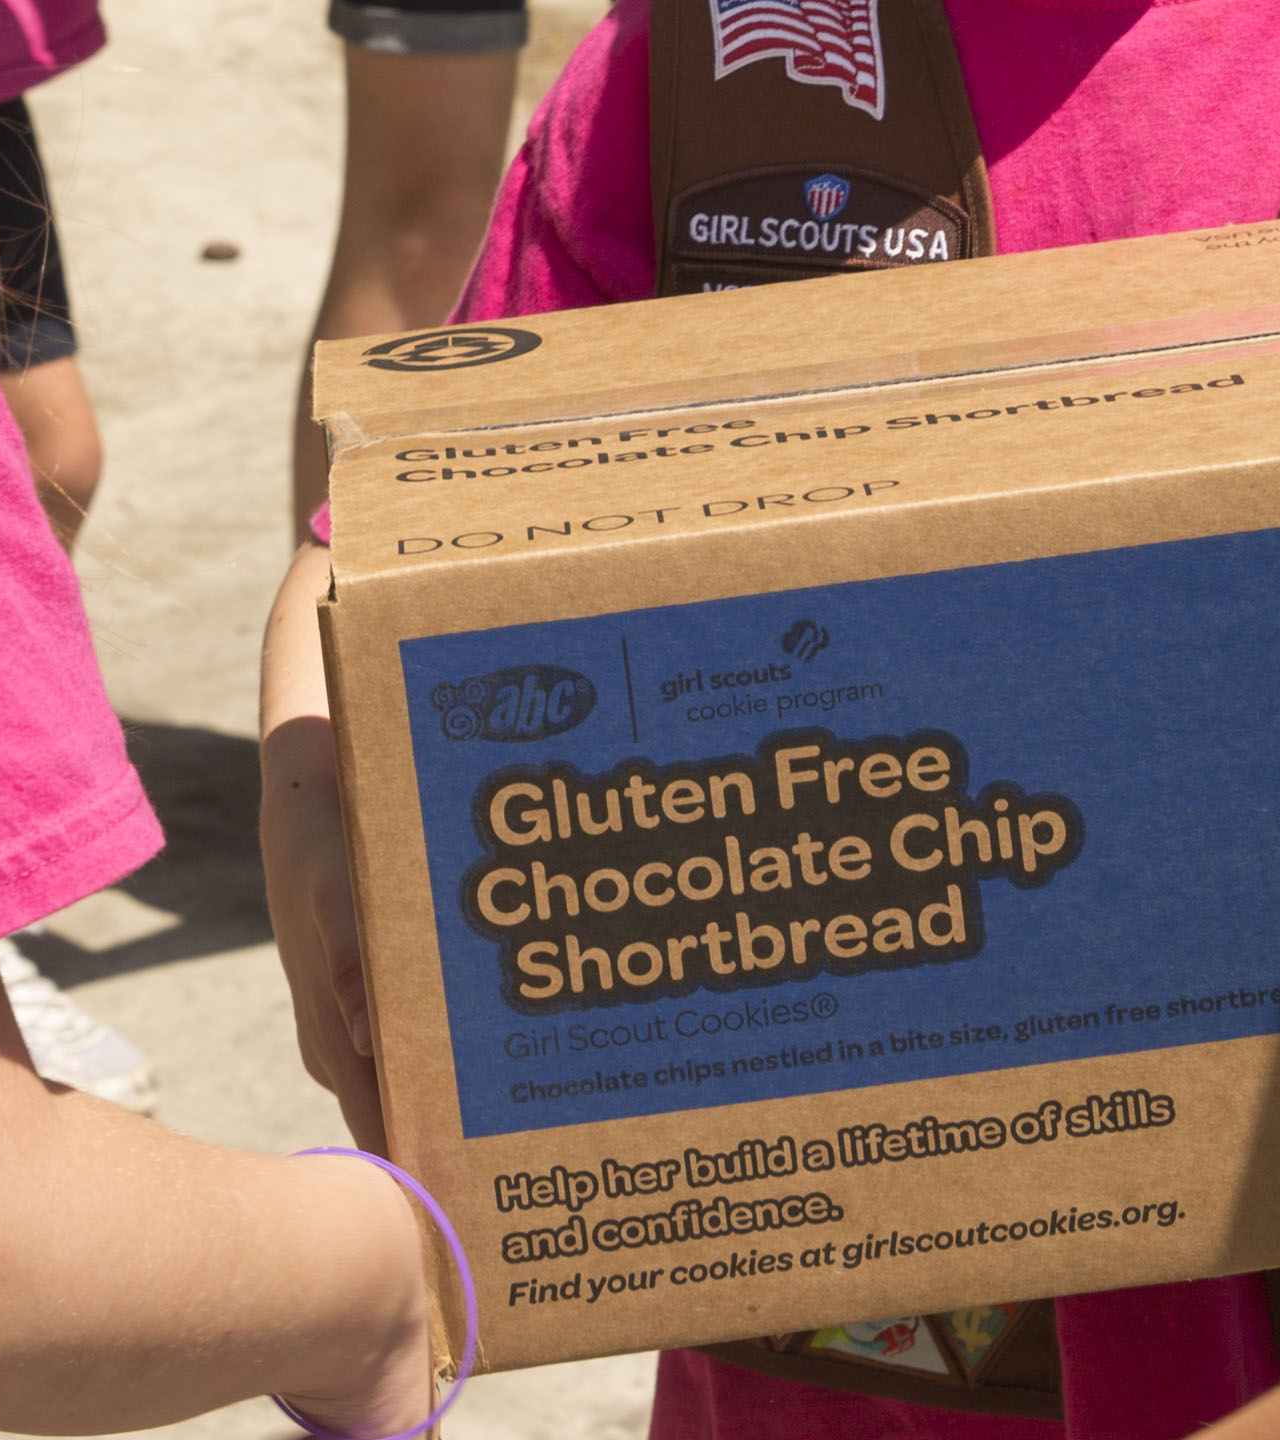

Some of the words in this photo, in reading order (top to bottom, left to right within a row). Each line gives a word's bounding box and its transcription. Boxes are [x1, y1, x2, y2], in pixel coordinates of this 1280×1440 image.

[689, 213, 755, 245] GIRL
[758, 218, 878, 258] SCOUTS
[884, 228, 949, 261] USA
[1204, 241, 1251, 250] the
[395, 443, 715, 483] Chocolate
[730, 417, 870, 449] Chip
[885, 373, 1245, 430] Shortbread
[395, 434, 602, 462] Gluten
[619, 420, 756, 443] Free
[397, 530, 504, 555] DO
[526, 506, 682, 542] NOT
[702, 479, 901, 519] DROP
[489, 672, 577, 737] abc
[659, 671, 703, 703] girl
[709, 661, 792, 687] scouts
[685, 691, 768, 723] cookie
[777, 678, 885, 718] program
[489, 775, 757, 848] Gluten
[773, 744, 952, 811] Free
[476, 834, 873, 927] Chocolate
[889, 797, 1068, 872] Chip
[515, 884, 968, 999] Shortbread
[503, 1027, 561, 1061] Girl
[568, 1014, 668, 1053] Scout
[674, 992, 840, 1039] Cookies®
[509, 1061, 649, 1104] Chocolate
[654, 1050, 727, 1086] chips
[731, 1040, 834, 1076] nestled
[838, 1038, 864, 1061] in
[868, 1039, 886, 1057] a
[889, 1025, 946, 1055] bite
[948, 1015, 1011, 1049] size,
[1013, 1007, 1100, 1045] gluten
[1105, 1000, 1162, 1025] free
[495, 1166, 599, 1212] Help
[601, 1159, 681, 1198] her
[685, 1135, 798, 1188] build
[803, 1140, 836, 1171] a
[837, 1116, 1007, 1168] lifetime
[1011, 1100, 1062, 1144] of
[1065, 1089, 1176, 1137] skills
[501, 1215, 589, 1264] and
[592, 1192, 845, 1252] confidence.
[508, 1272, 582, 1307] Find
[586, 1266, 664, 1304] your
[670, 1249, 793, 1286] cookies
[799, 1241, 836, 1268] at
[842, 1200, 1186, 1269] girlscoutcookies.org.
